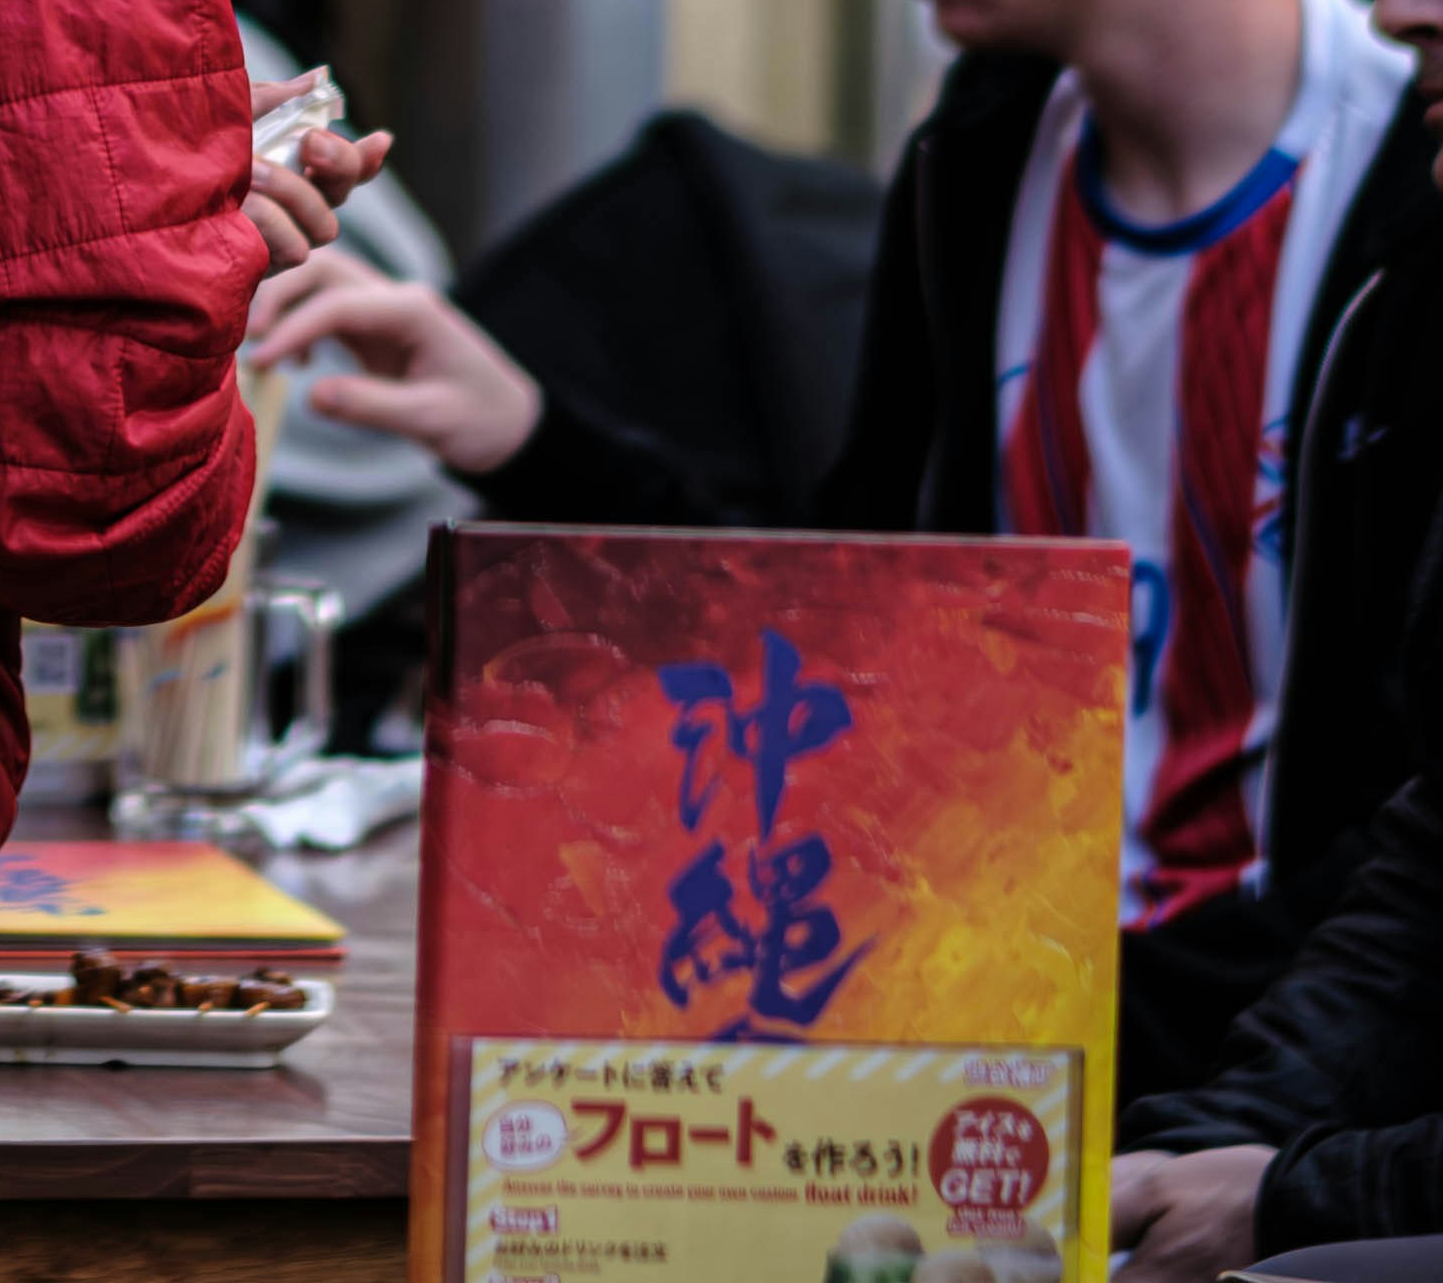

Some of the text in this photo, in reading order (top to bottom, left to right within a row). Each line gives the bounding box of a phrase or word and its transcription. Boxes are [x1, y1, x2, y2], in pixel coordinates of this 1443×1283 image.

[658, 627, 880, 1043] 沖縄
[498, 1057, 724, 1094] アンケートに答えて
[805, 1182, 850, 1204] float
[857, 1183, 919, 1207] drink!
[940, 1167, 1032, 1205] GET!
